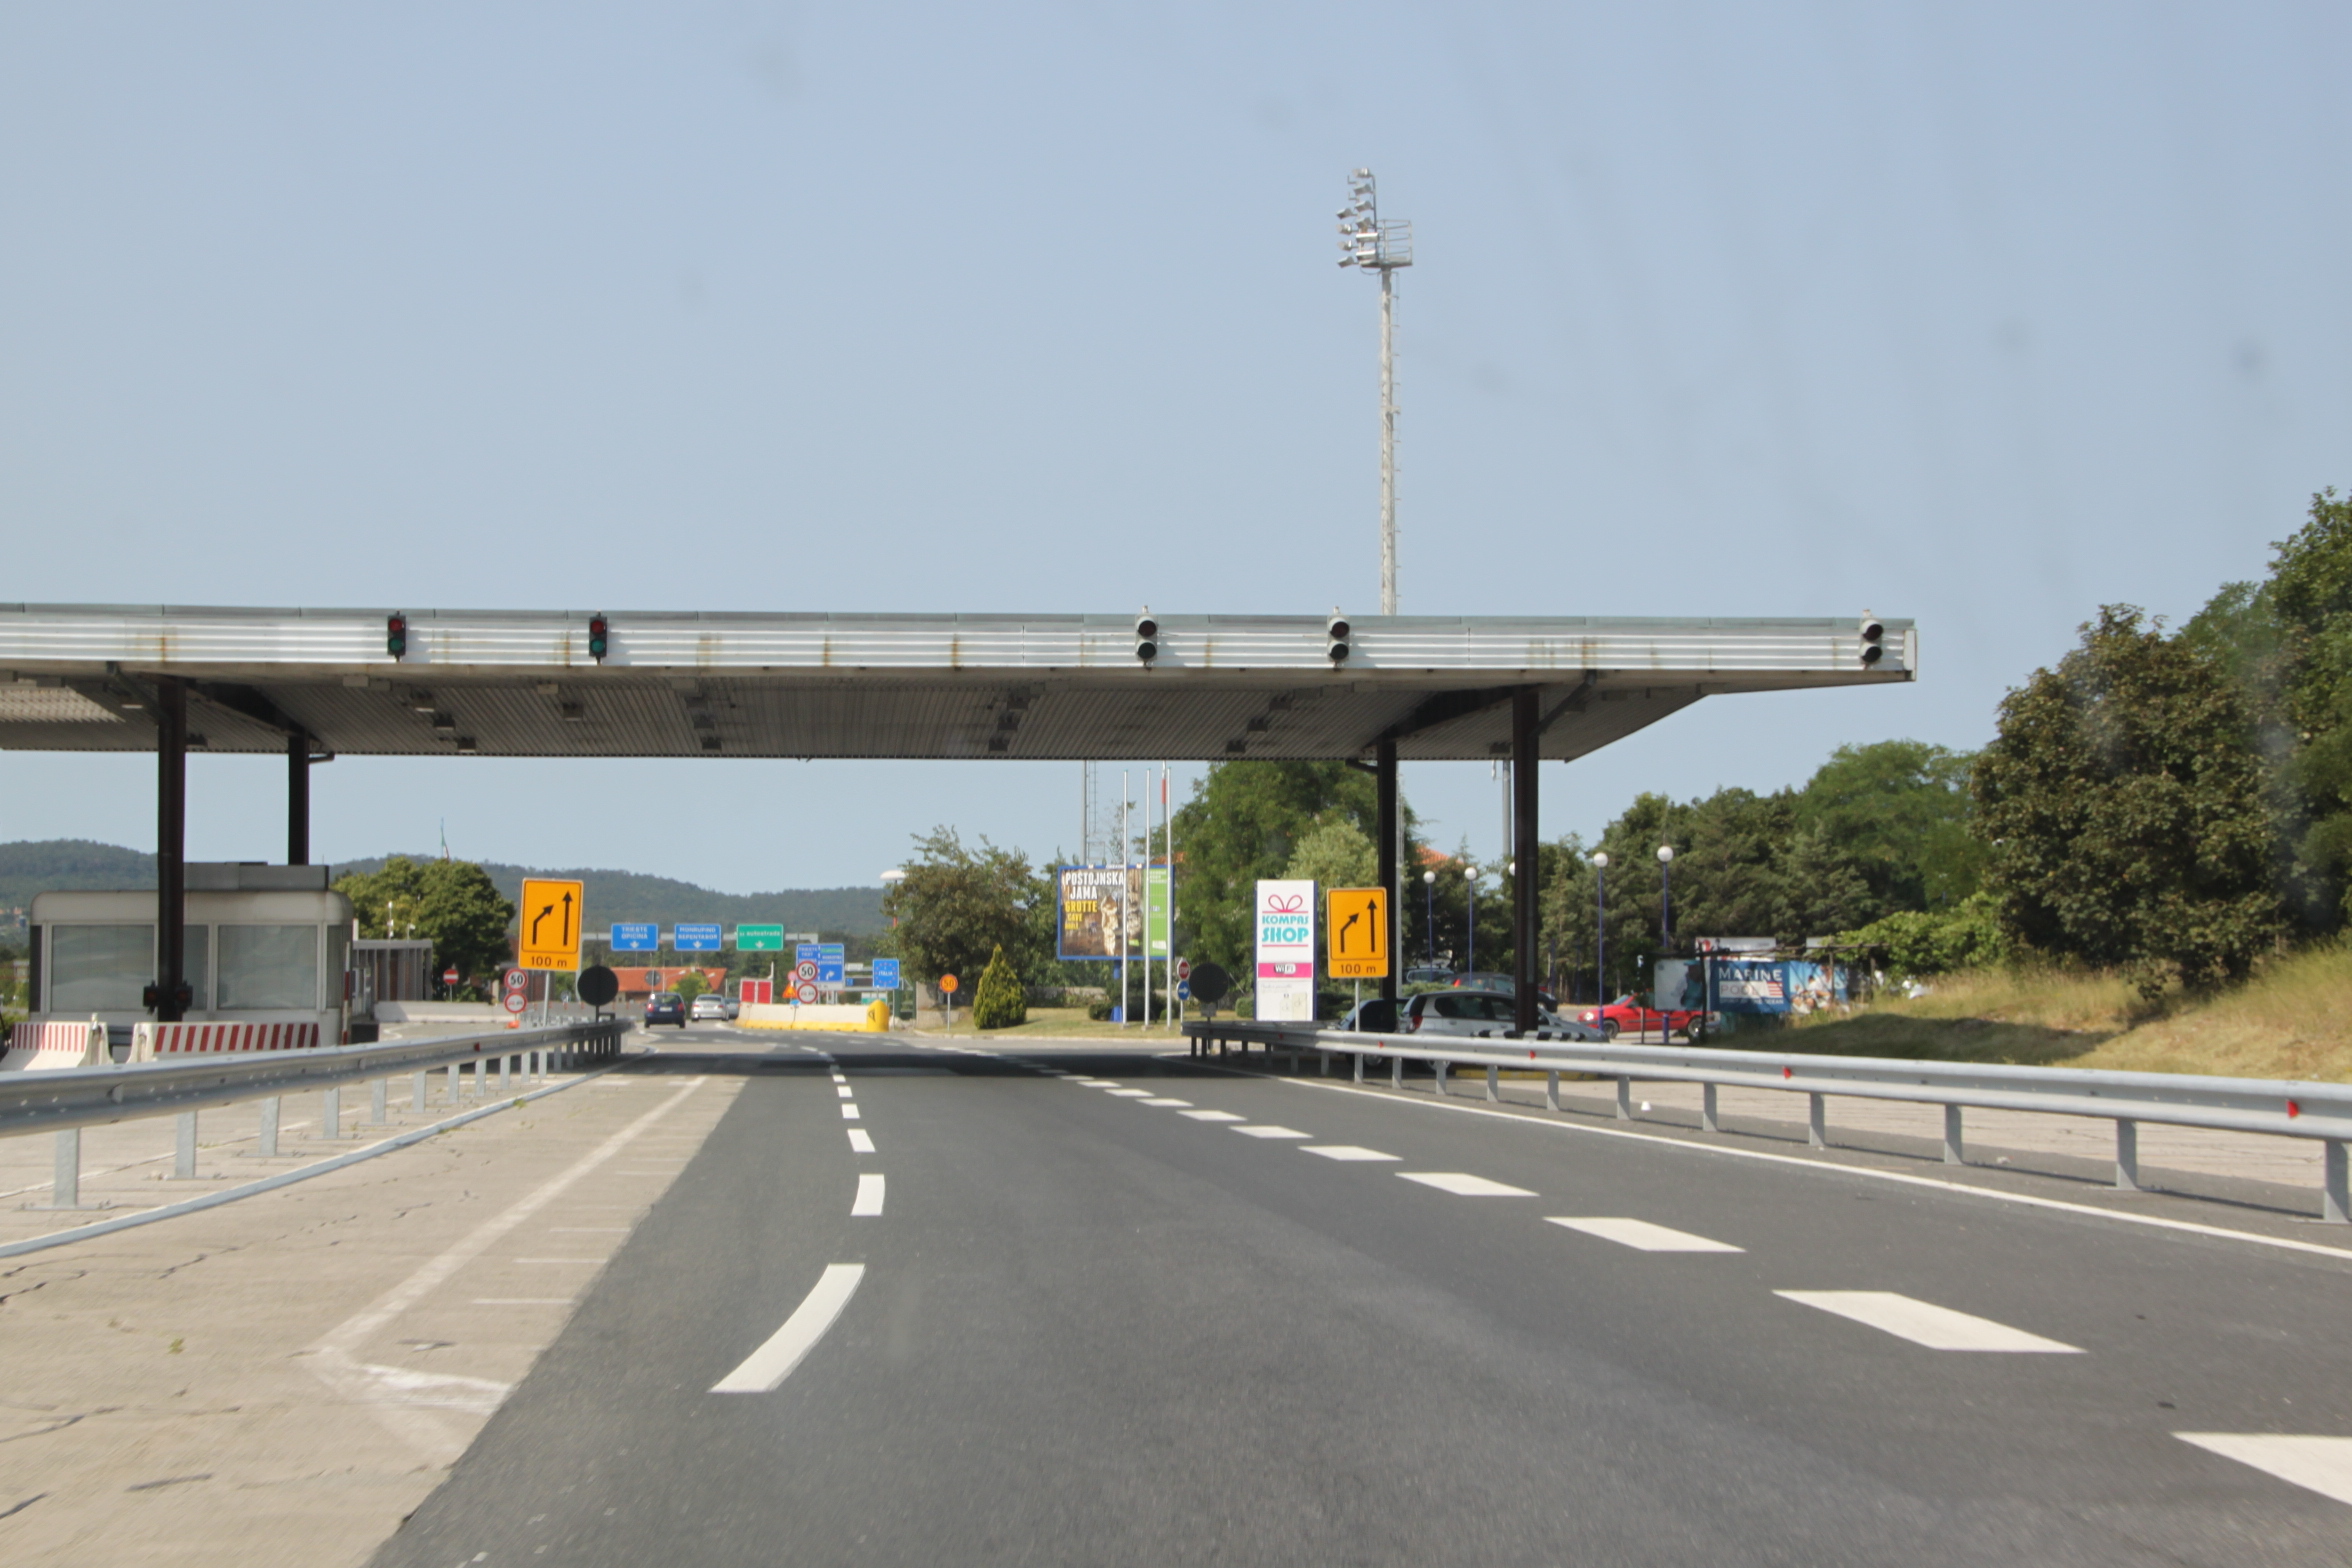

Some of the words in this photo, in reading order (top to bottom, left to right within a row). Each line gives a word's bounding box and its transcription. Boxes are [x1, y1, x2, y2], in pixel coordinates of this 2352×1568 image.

[1066, 871, 1124, 885] POSTOJNSKA
[1071, 886, 1098, 900] JAMA
[1065, 900, 1098, 913] GROTTE
[1262, 915, 1309, 925] KOMPAS
[1261, 927, 1309, 942] SHOP
[532, 956, 551, 967] 100
[557, 959, 567, 967] m
[801, 965, 814, 977] 50
[1341, 964, 1361, 974] 100
[1366, 965, 1377, 974] m
[1719, 967, 1783, 981] MARINE
[510, 974, 523, 986] 50
[944, 979, 954, 989] 50
